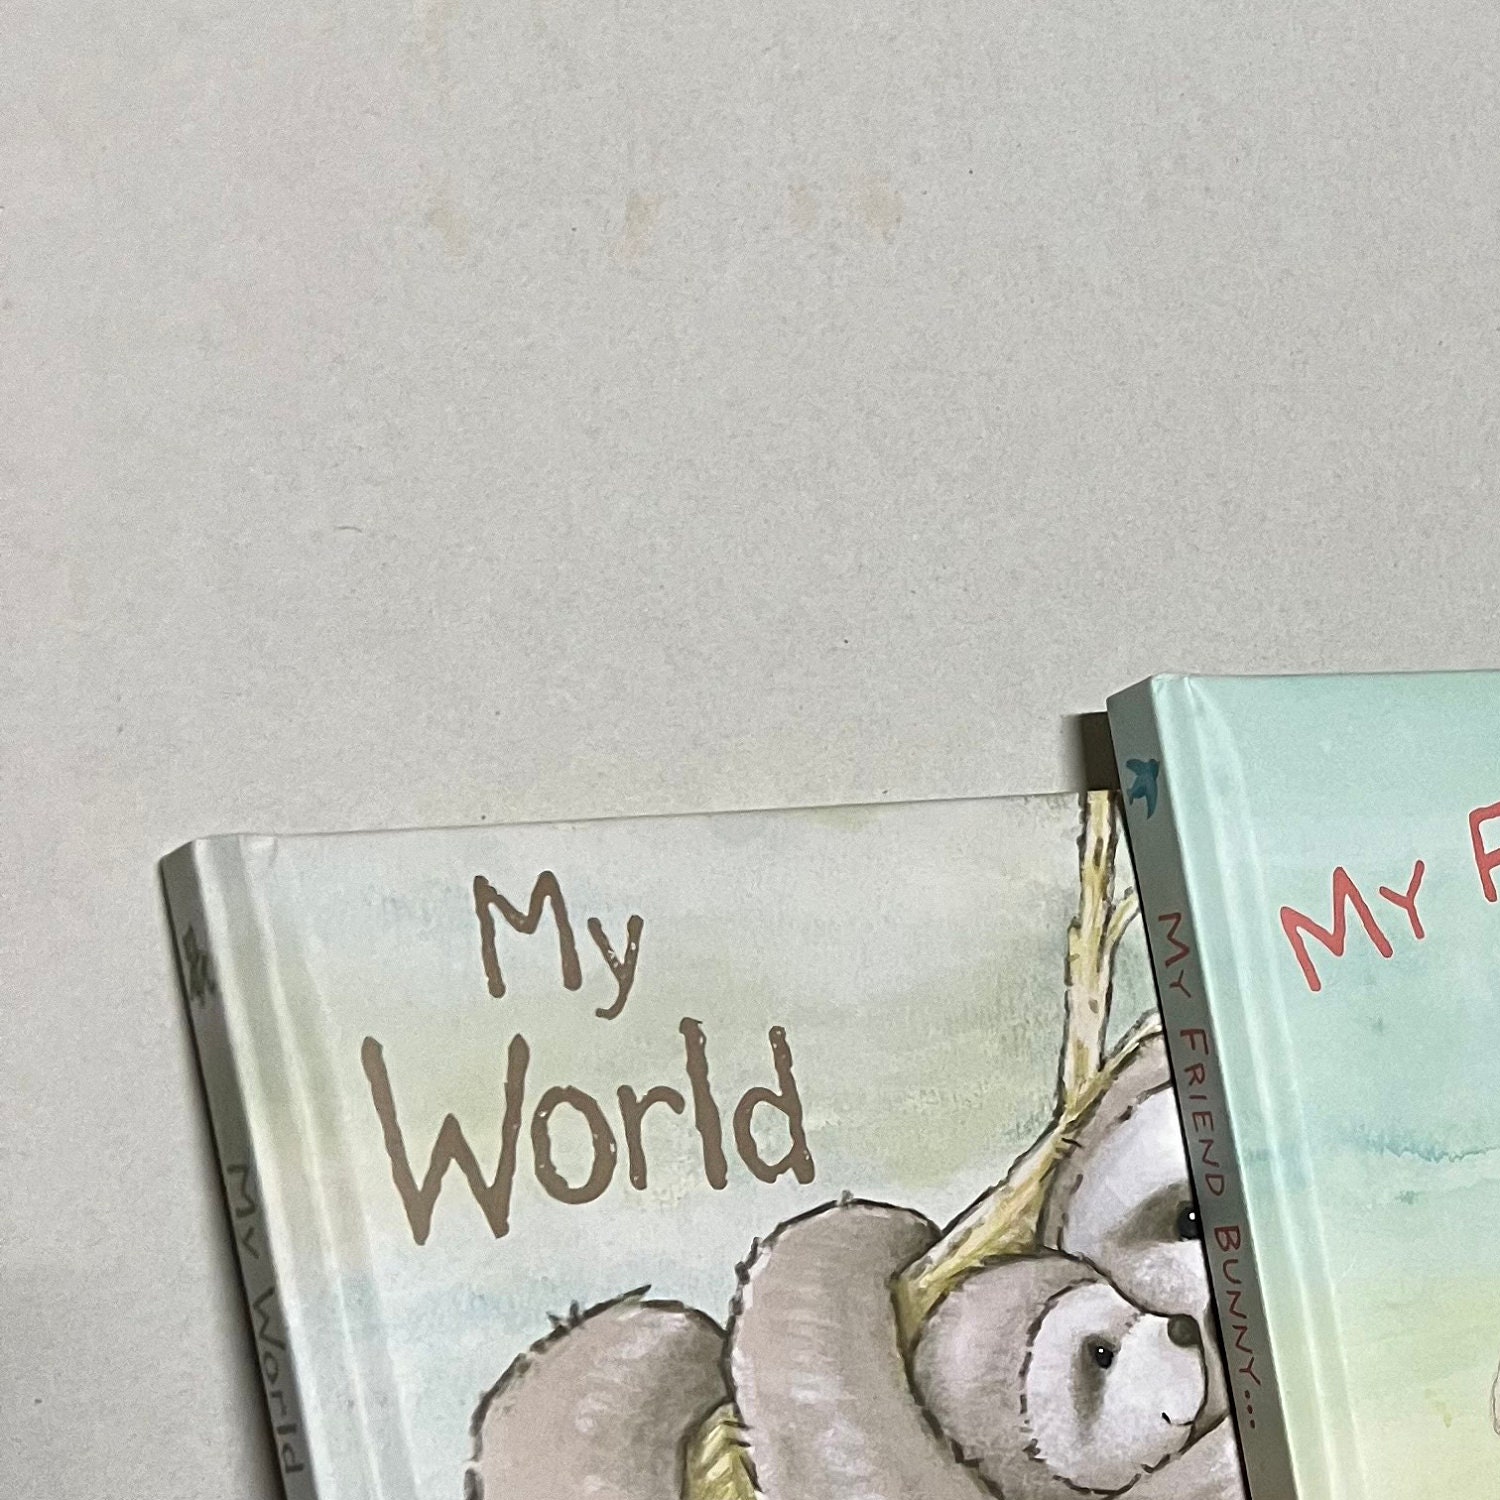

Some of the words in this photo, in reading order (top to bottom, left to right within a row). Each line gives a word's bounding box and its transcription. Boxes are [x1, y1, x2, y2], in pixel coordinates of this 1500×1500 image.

[473, 871, 644, 1020] My
[1280, 860, 1425, 992] MY
[361, 1017, 814, 1245] World
[1158, 911, 1191, 998] MY
[1180, 1028, 1225, 1196] FRIEND
[1213, 1225, 1261, 1429] BUNNY...
[226, 1163, 259, 1260] My
[252, 1286, 304, 1474] World
